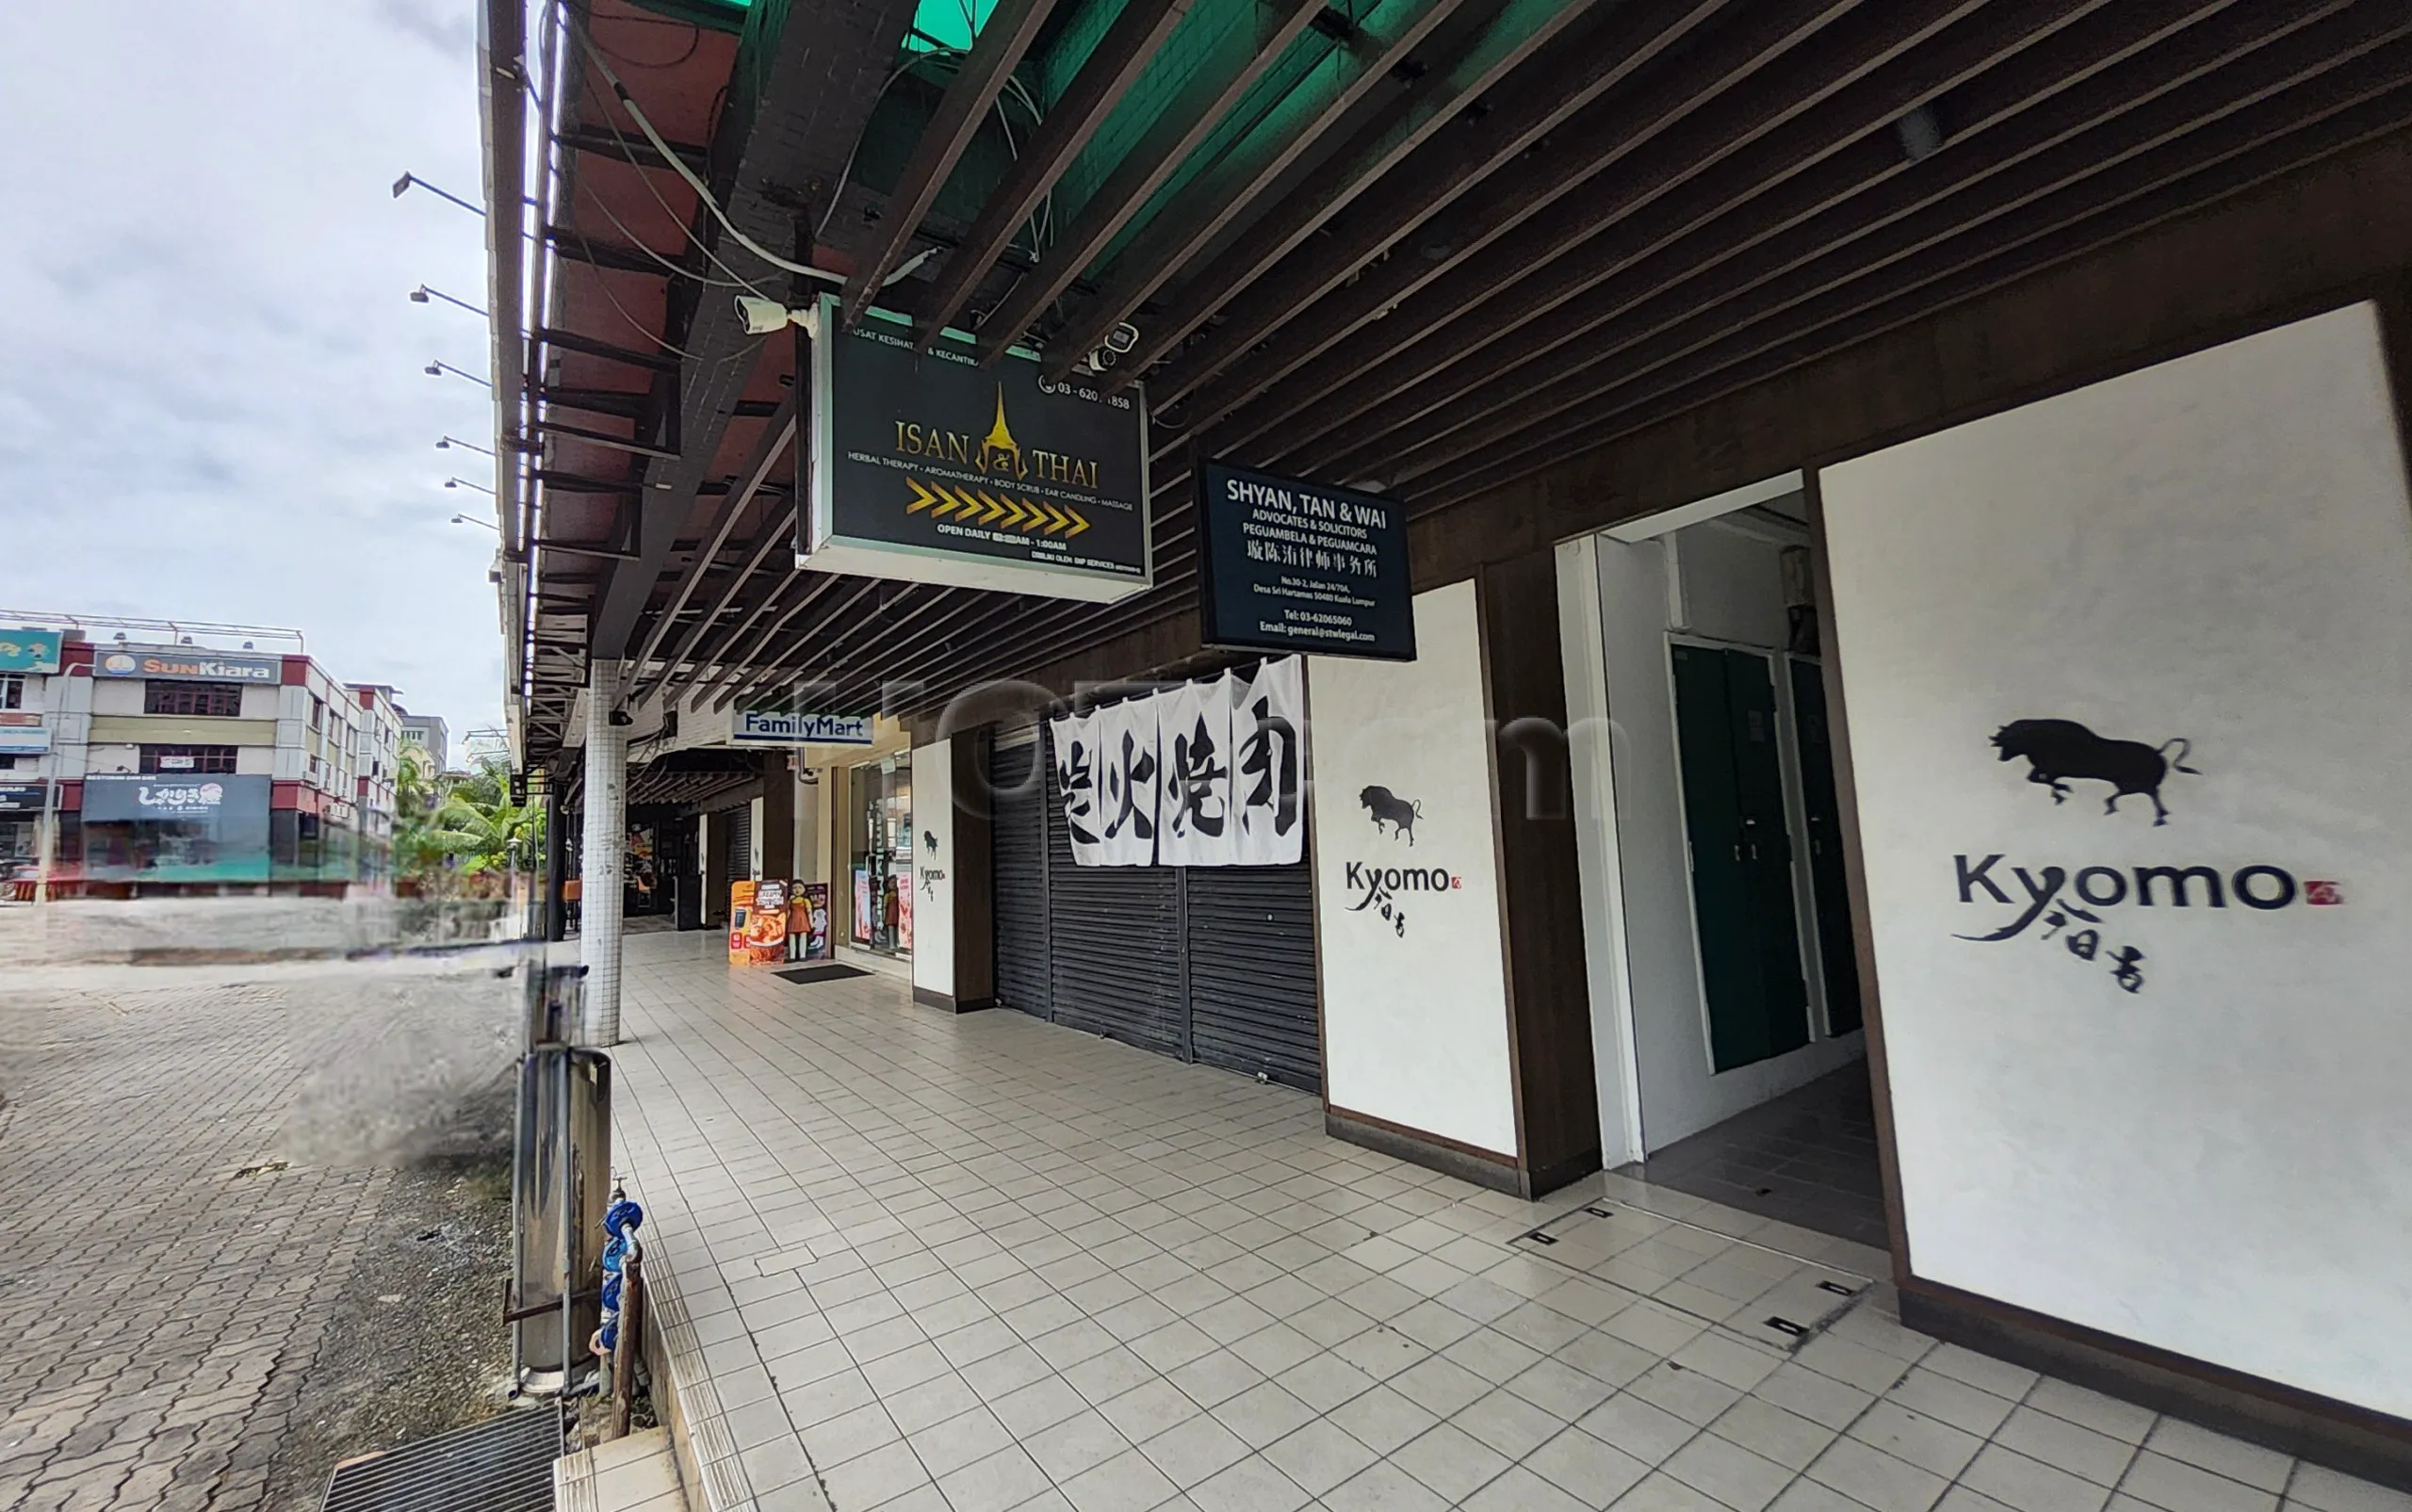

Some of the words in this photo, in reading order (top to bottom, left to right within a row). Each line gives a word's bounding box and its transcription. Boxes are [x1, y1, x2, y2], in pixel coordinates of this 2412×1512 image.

[927, 347, 934, 356] &
[1057, 382, 1071, 395] 03
[895, 420, 970, 465] ISAN
[993, 451, 1010, 472] &
[1032, 448, 1099, 489] THAI
[847, 451, 881, 465] HERBAL
[882, 457, 919, 471] THERAPY
[924, 466, 989, 485] AROMATHERAPY
[994, 479, 1015, 489] BODY
[1017, 482, 1040, 495] SCRUB
[1045, 487, 1059, 497] EAR
[1101, 499, 1133, 512] MASSAGE
[1227, 479, 1297, 514] SHYAN,
[1298, 494, 1336, 520] TAN
[1339, 502, 1353, 523] &
[1353, 504, 1387, 529] WAI
[937, 523, 963, 536] OPEN
[964, 528, 991, 540] DAILY
[1035, 539, 1067, 551] 1:00AM
[1251, 508, 1309, 528] ADVOCATES
[1309, 519, 1317, 530] &
[1318, 520, 1368, 540] SOLICITORS
[1242, 522, 1308, 544] PEGUAMBELA
[1309, 533, 1316, 545] &
[1317, 535, 1377, 556] PEGUAMCARA
[1253, 583, 1271, 594] Desa
[1272, 586, 1281, 594] Sri
[1282, 588, 1313, 599] Hartamas
[1334, 593, 1351, 604] Kuala
[1352, 596, 1376, 608] Lumpur
[1309, 580, 1327, 590] Jalan
[1283, 609, 1299, 621] Tel:
[1299, 610, 1353, 626] 03-62065060
[1259, 620, 1287, 634] Email:
[1287, 625, 1376, 642] general@stwlegal.com
[745, 713, 863, 737] FamilyMart
[920, 866, 943, 890] Kyomo
[1344, 861, 1450, 911] Kyomo
[1949, 853, 2298, 942] Kyomo
